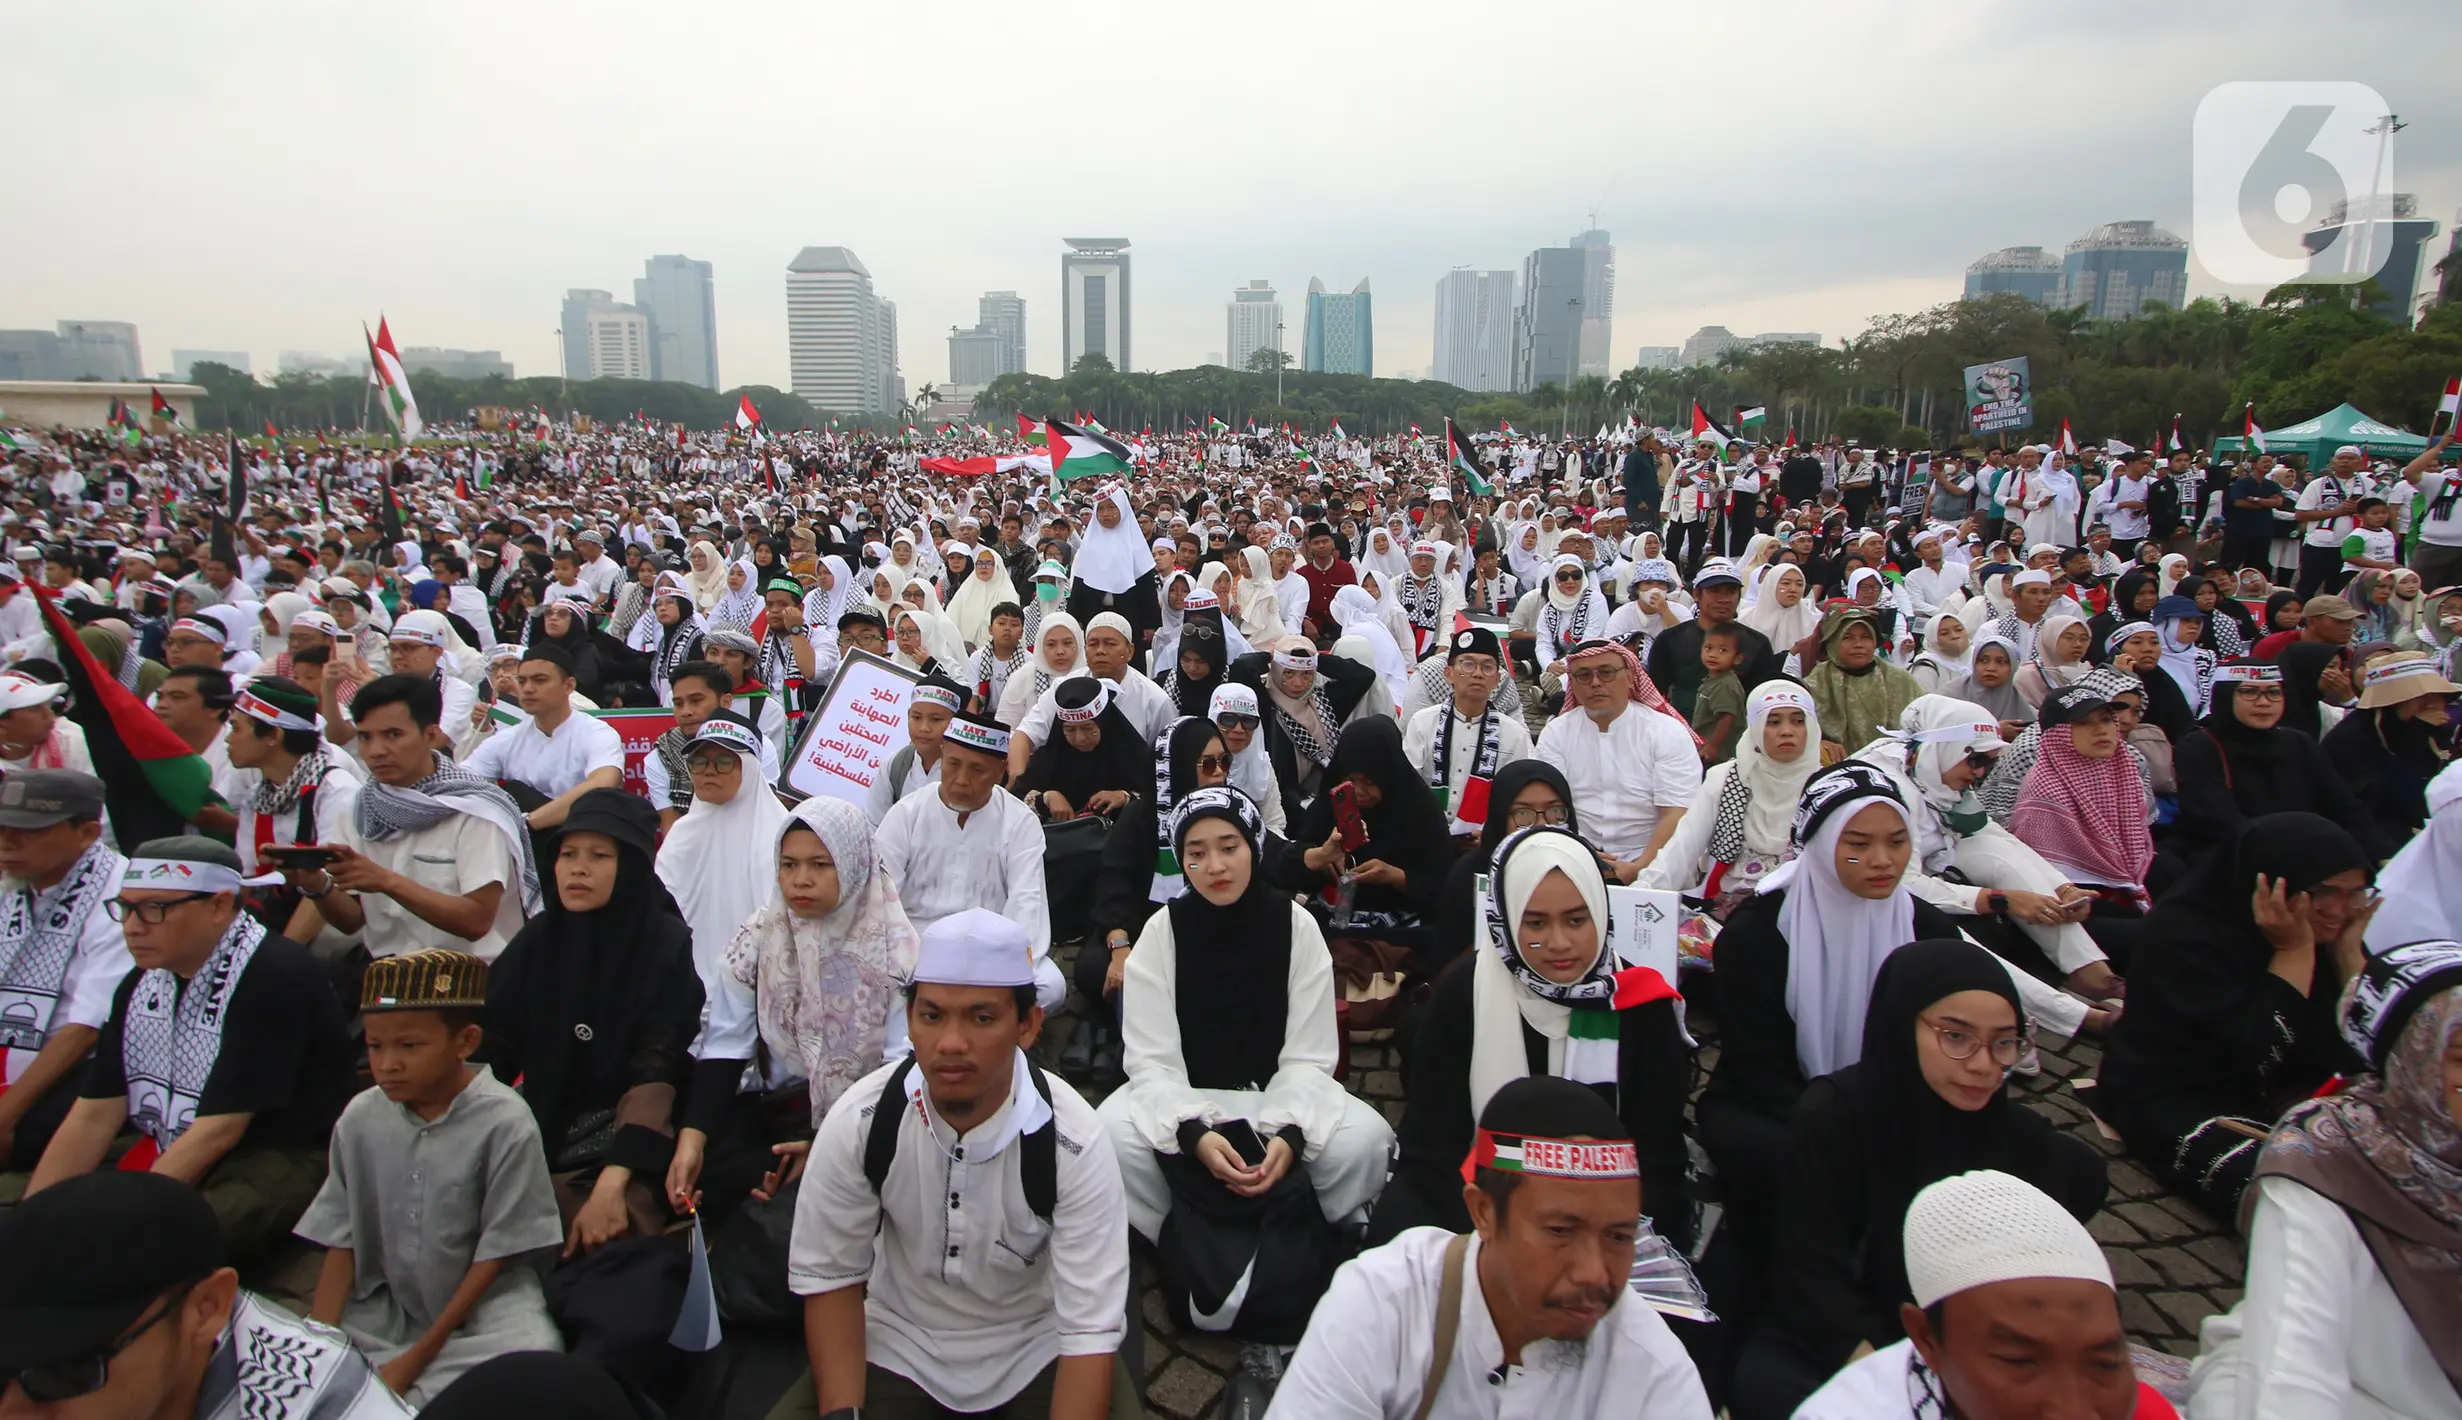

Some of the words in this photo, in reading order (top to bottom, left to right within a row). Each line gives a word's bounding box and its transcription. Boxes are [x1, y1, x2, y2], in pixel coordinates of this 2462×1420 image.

[1983, 401, 1998, 411] END
[2001, 399, 2016, 408] THE
[1973, 408, 2017, 422] APARTHEID
[1980, 417, 2022, 430] PALESTINE
[870, 687, 900, 704] اطرد
[850, 699, 900, 728] الصهاينة
[701, 727, 747, 740] ALESTINE
[839, 720, 890, 747] المحتلين
[963, 725, 988, 737] SAVE
[818, 738, 869, 761] الأراضي
[1524, 1141, 1565, 1169] FREE
